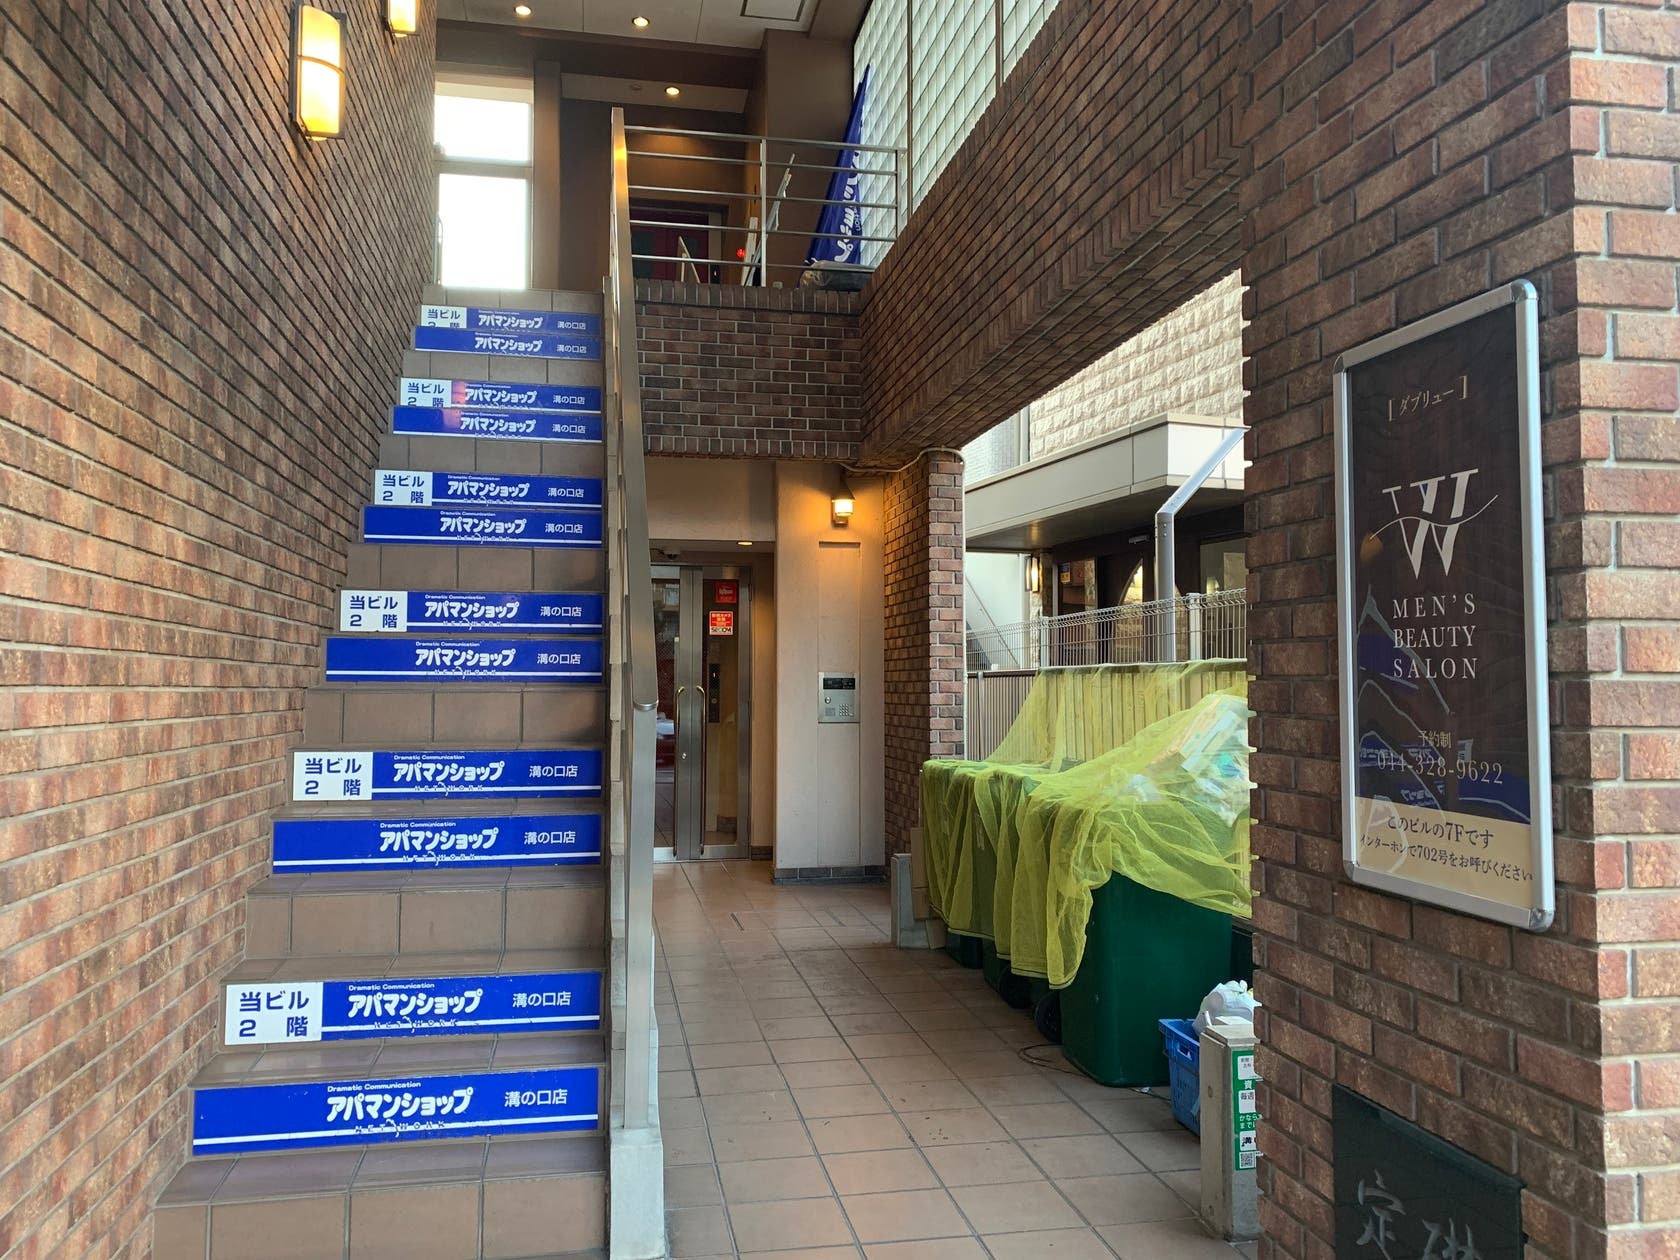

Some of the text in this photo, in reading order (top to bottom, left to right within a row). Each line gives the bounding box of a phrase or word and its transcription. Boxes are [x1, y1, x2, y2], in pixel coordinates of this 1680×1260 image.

[428, 308, 461, 320] 当ビル
[478, 314, 543, 328] アパマンショップ
[475, 337, 543, 352] アパマンショップ
[408, 382, 444, 394] 当ビル
[465, 388, 585, 404] アパマンショップ 溝の口店
[408, 397, 444, 408] 2 階
[460, 417, 586, 434] アパマンショップ 溝の口店
[382, 474, 424, 488] 当ビル
[448, 480, 585, 498] アパマンショップ 溝の口店
[382, 491, 424, 504] 2 階
[440, 517, 583, 534] アパマンショップ 溝の口店
[1382, 468, 1478, 580] W
[350, 596, 398, 610] 当ビル
[425, 601, 582, 619] アパマンショップ 溝の口店
[1393, 593, 1476, 619] MEN'S
[349, 614, 398, 628] 2 階
[1393, 626, 1476, 648] BEAUTY
[416, 648, 581, 667] アパマンショップ 溝の口店
[1393, 658, 1478, 680] SALON
[1418, 730, 1452, 748] 予約制
[305, 758, 362, 774] 当ビル
[394, 760, 578, 782] アパマンショップ 溝の口店
[306, 780, 361, 796] 2 階
[380, 828, 576, 851] アパマンショップ 溝の口店
[1388, 816, 1494, 848] このビルの7Fです
[1360, 834, 1533, 881] インターホンで702号をお呼びください
[240, 990, 309, 1012] 当ビル
[348, 989, 572, 1018] アパマンショップ 溝の口店
[240, 1016, 308, 1038] 2 階
[364, 1082, 421, 1090] Communication
[327, 1086, 568, 1122] アパマンショップ 溝の口店
